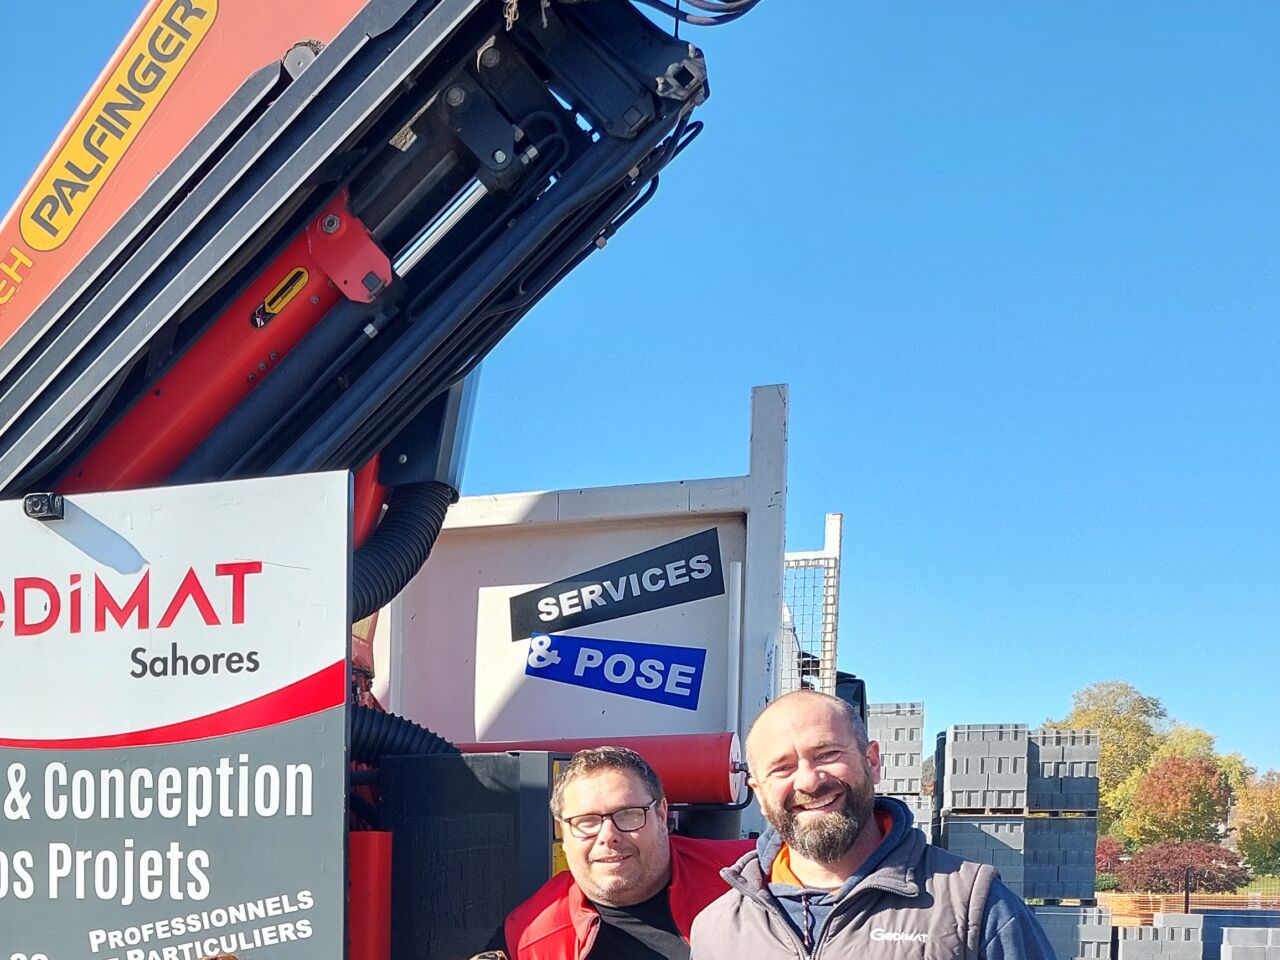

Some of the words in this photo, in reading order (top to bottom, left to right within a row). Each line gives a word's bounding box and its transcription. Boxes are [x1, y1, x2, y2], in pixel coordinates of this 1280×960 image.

[30, 0, 207, 237] PALFINGER
[537, 554, 713, 622] SERVICES
[130, 642, 260, 679] Sahores
[527, 634, 562, 669] &
[573, 646, 697, 697] POSE
[3, 762, 31, 820] &
[44, 753, 313, 827] Conception
[48, 841, 210, 905] Projets
[88, 890, 314, 953] PROFESSIONNELS
